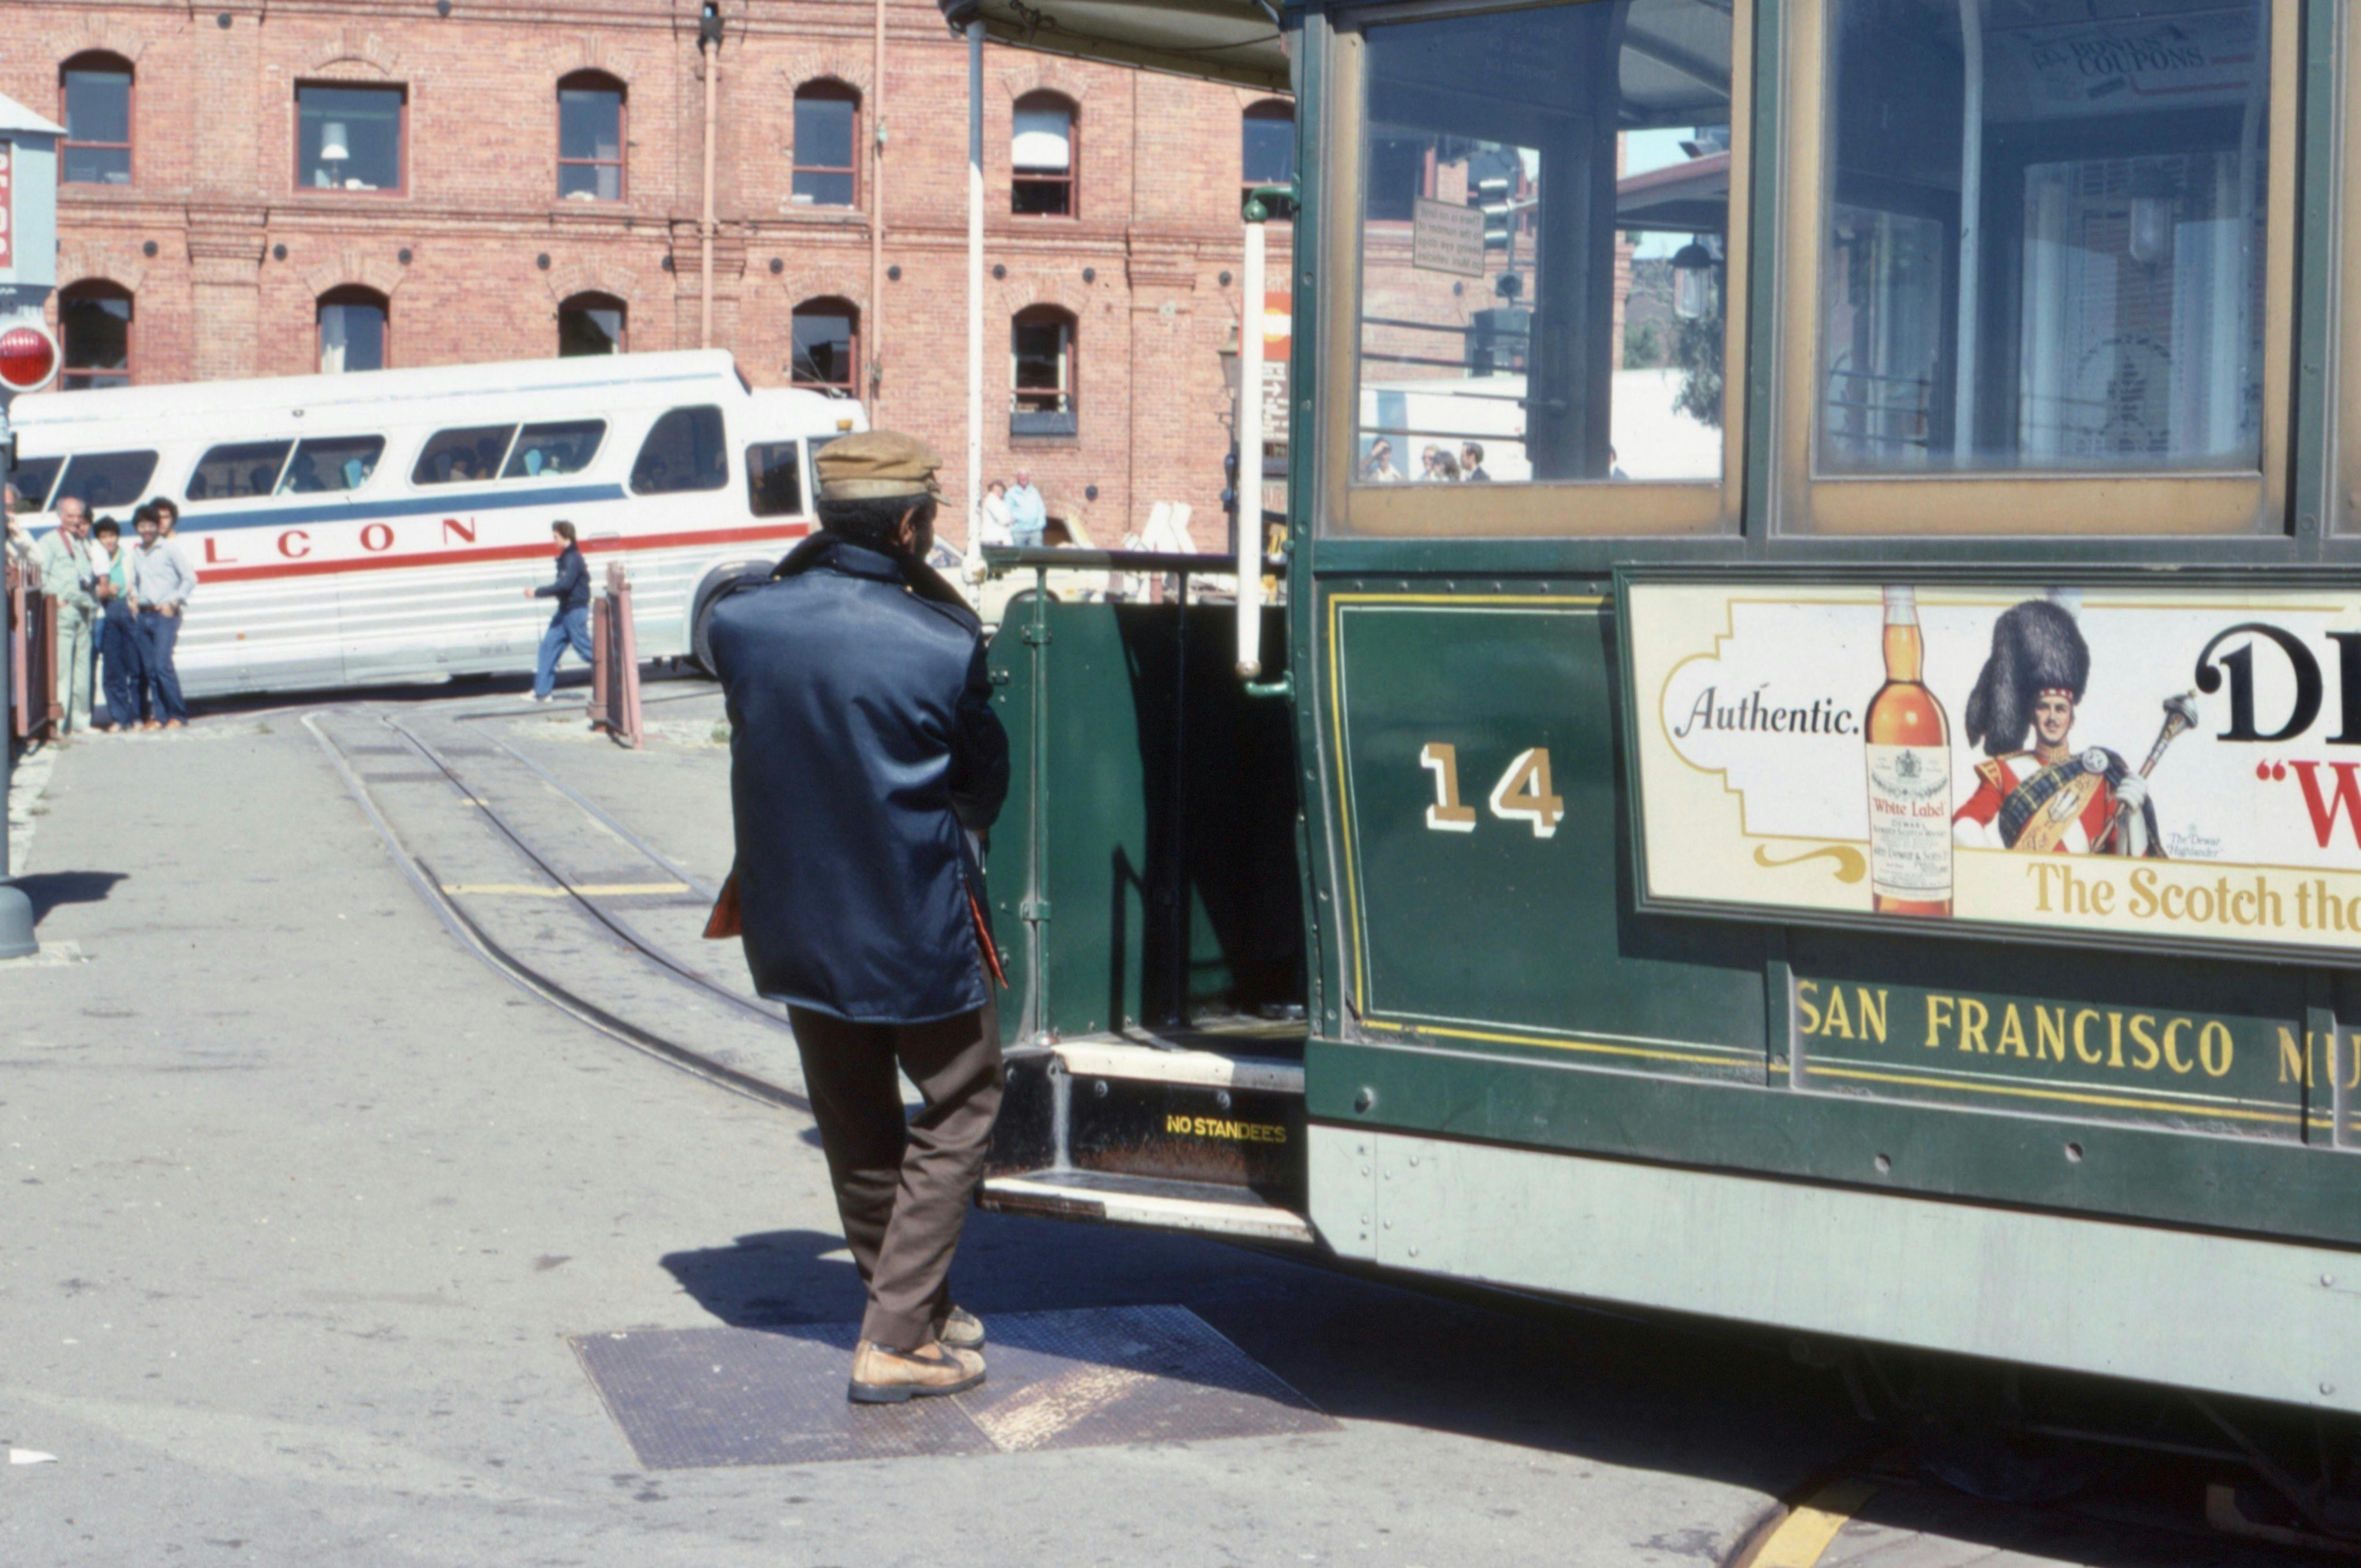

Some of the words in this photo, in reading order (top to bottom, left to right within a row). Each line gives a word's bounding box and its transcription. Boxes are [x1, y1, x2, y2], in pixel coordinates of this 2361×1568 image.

[2077, 47, 2205, 76] COUPONS
[204, 517, 477, 564] LCON
[1674, 685, 1859, 738] Authentic.
[1420, 742, 1564, 838] 14
[1911, 801, 1945, 817] Label
[2027, 862, 2115, 915] The
[2129, 867, 2286, 927] Scotch
[1794, 980, 1888, 1044] SAN
[1924, 995, 2234, 1077] FRANCISCO
[1166, 1114, 1192, 1134] NO
[1194, 1117, 1287, 1143] STANDEES
